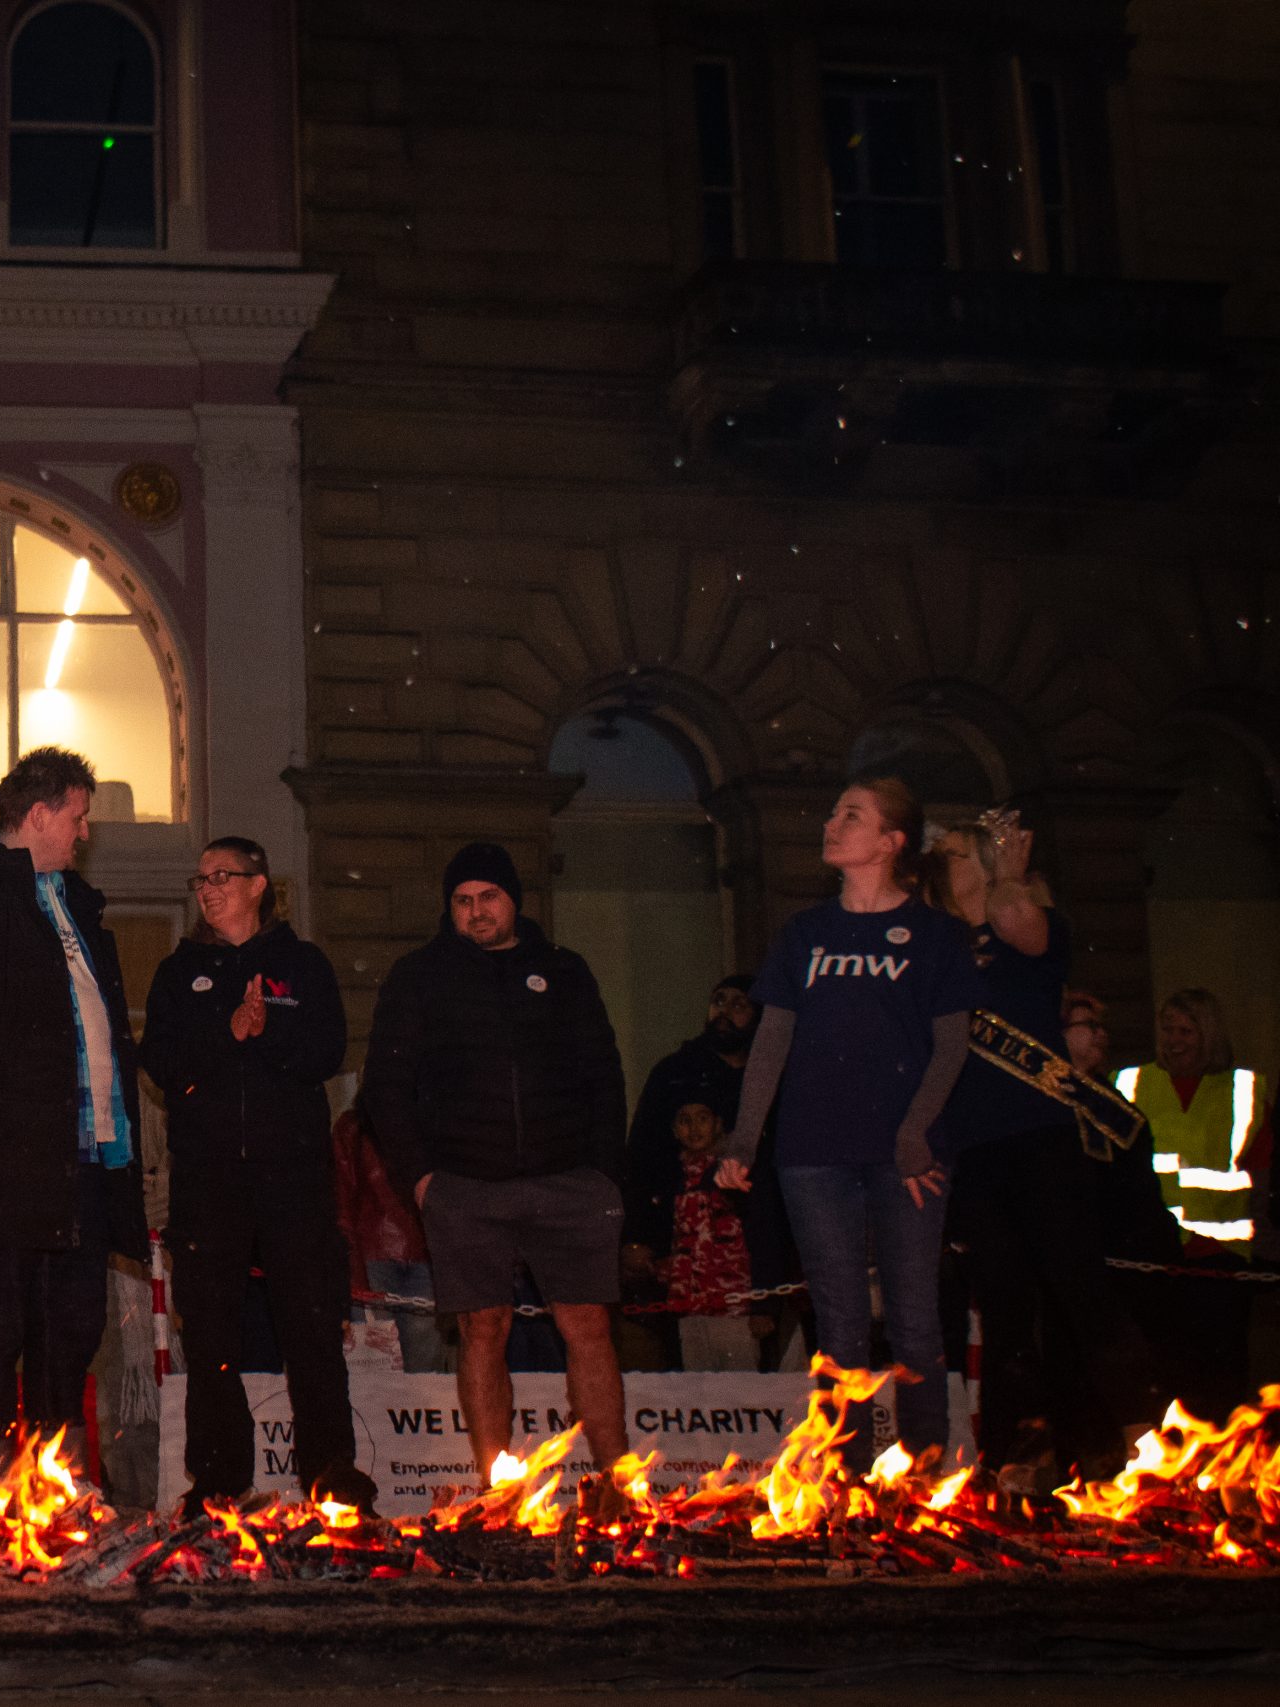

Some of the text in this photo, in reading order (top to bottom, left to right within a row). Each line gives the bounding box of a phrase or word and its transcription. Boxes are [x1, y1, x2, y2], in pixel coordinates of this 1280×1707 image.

[804, 946, 911, 990] jmw
[387, 1408, 443, 1435] WE
[635, 1408, 785, 1434] CHARITY
[394, 1483, 426, 1496] and
